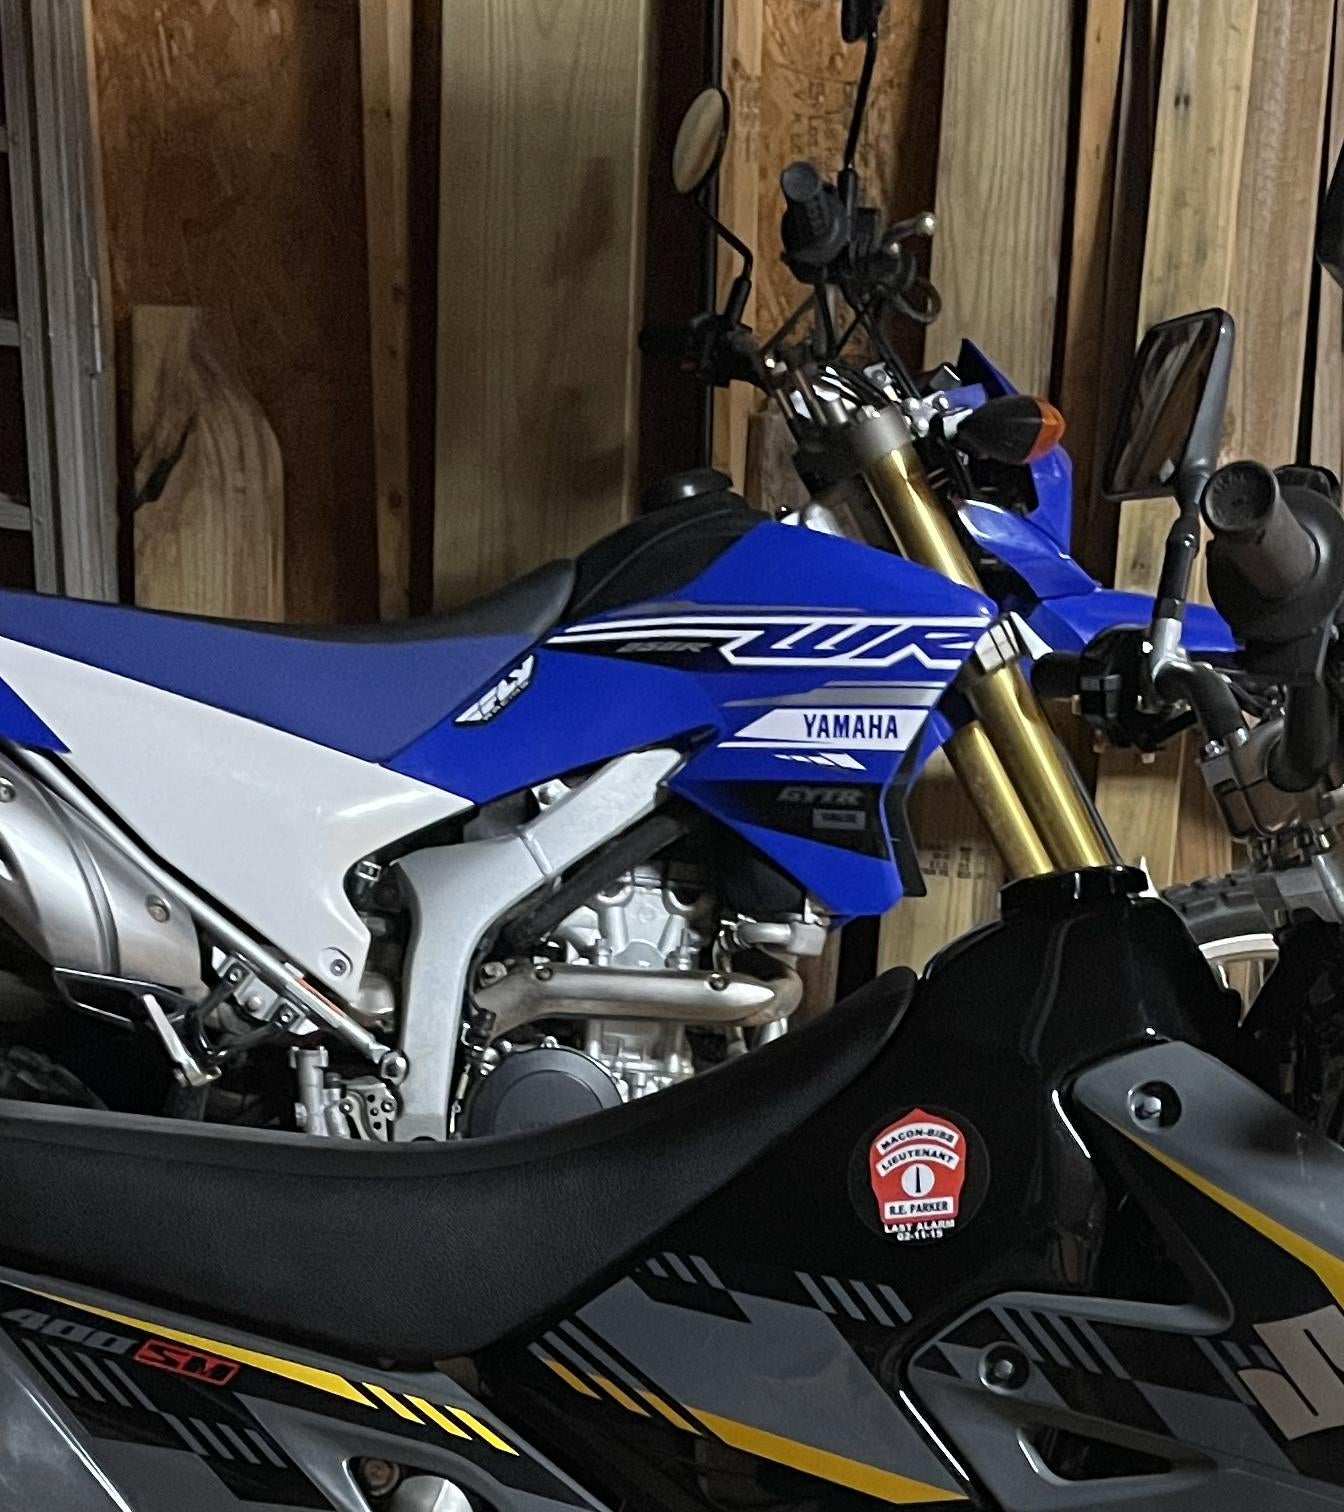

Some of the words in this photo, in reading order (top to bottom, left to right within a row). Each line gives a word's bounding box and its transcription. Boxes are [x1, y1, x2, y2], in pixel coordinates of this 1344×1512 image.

[803, 714, 898, 739] YAMAHA
[881, 1148, 954, 1171] LIEUTENANT
[910, 1201, 948, 1214] PARKER
[916, 1219, 955, 1231] ALARM
[1, 1308, 139, 1355] 400
[137, 1340, 237, 1384] SM
